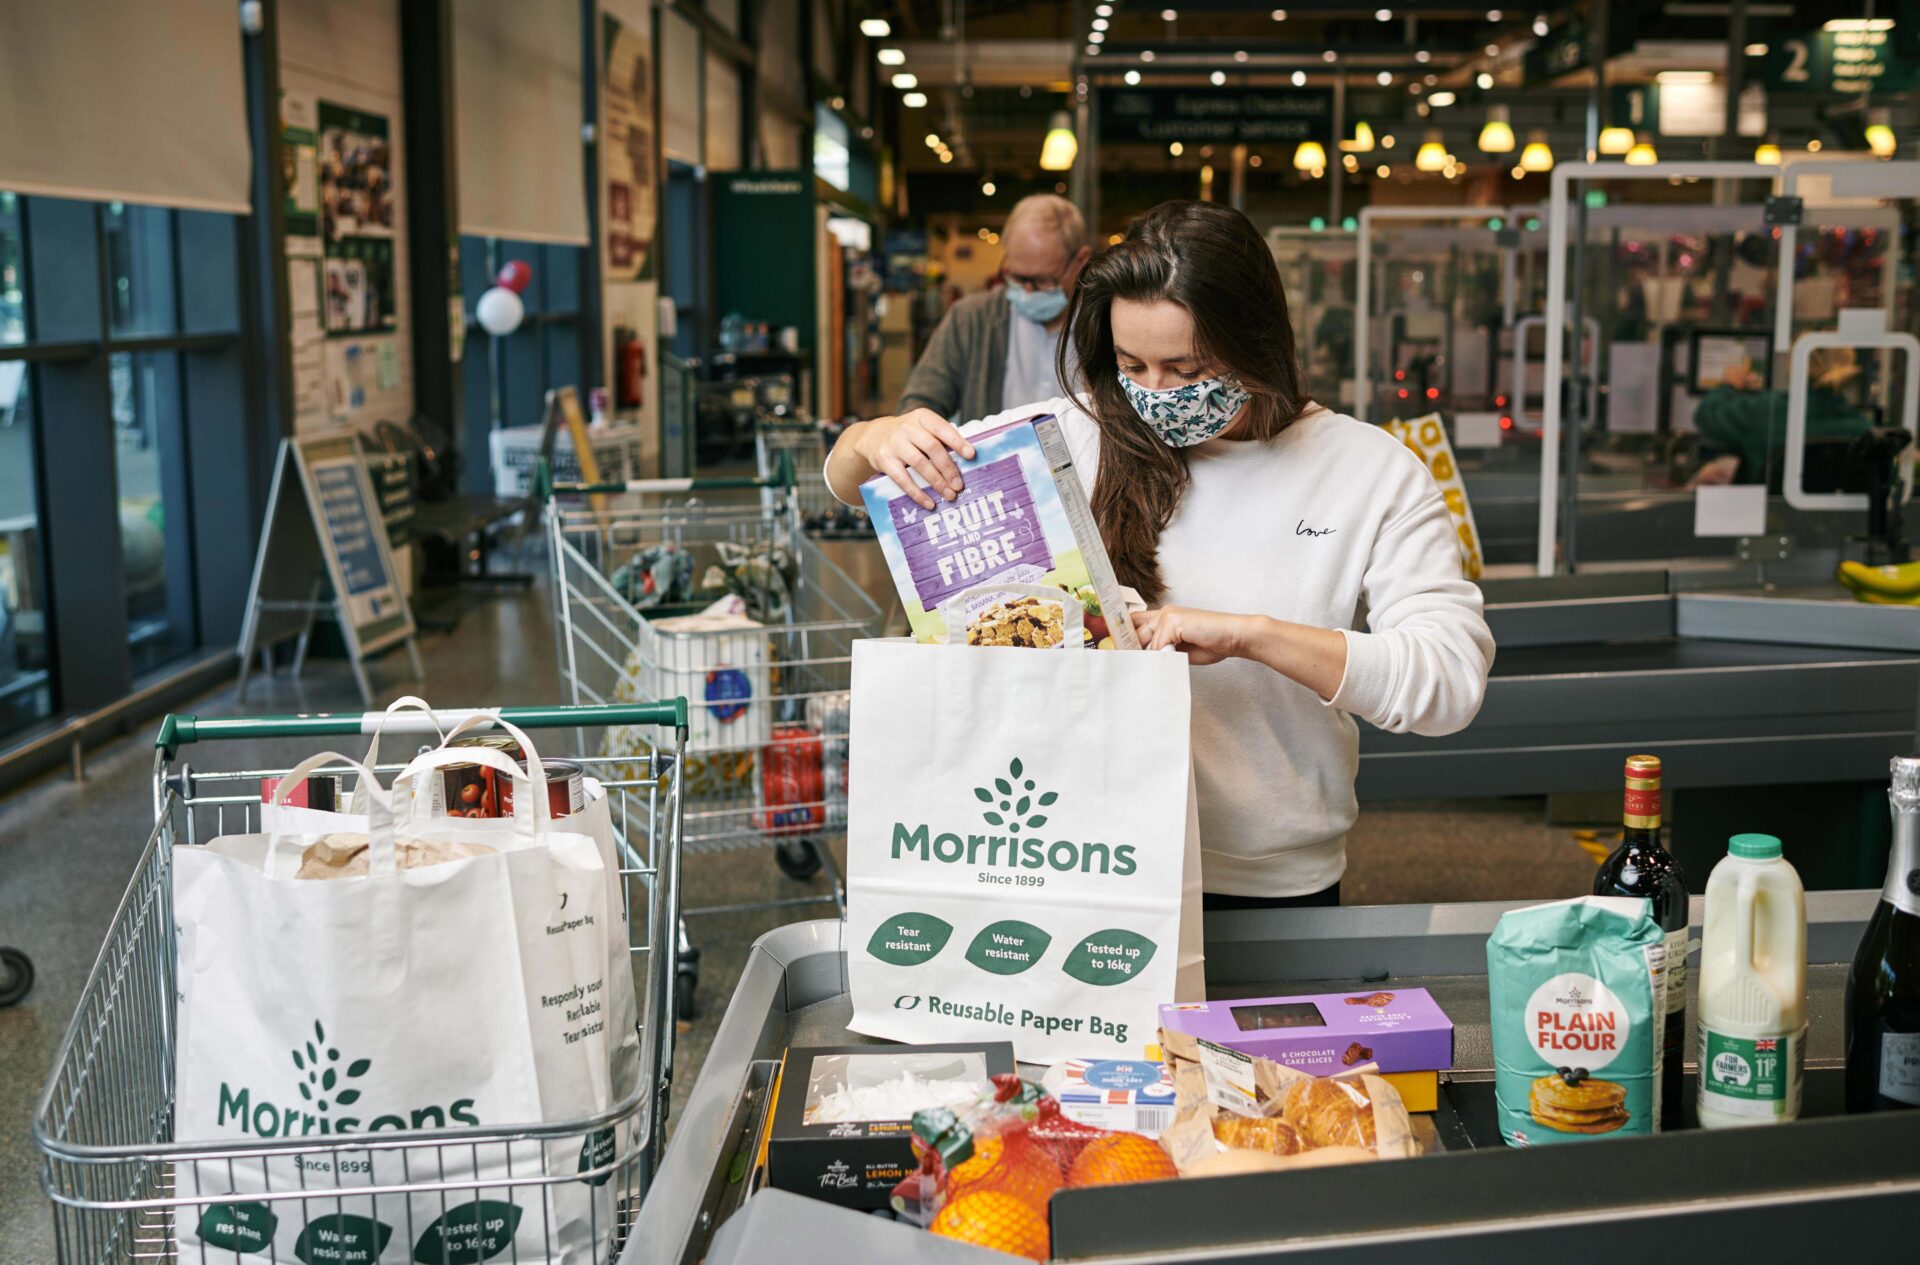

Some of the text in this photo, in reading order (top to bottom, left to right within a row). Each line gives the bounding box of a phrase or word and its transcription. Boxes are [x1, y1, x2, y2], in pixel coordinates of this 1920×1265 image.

[1783, 40, 1809, 81] 2
[923, 490, 1007, 545] FRUIT
[963, 532, 981, 546] AND
[937, 531, 1022, 586] FIBRE
[891, 822, 1137, 876] Morrisons
[978, 872, 1045, 887] Since 1899
[897, 926, 920, 937] Tear
[885, 940, 931, 952] resistant
[992, 934, 1024, 946] Water
[985, 948, 1030, 962] resistant
[1085, 943, 1140, 959] Tested up
[1091, 958, 1132, 974] to 16kg
[929, 996, 1128, 1043] Reusable Paper Bag
[1537, 1011, 1615, 1032] PLAIN
[1538, 1032, 1616, 1050] FLOUR
[1289, 1049, 1335, 1058] CHOCOLATE
[1307, 1056, 1333, 1064] SLICES
[1725, 1054, 1738, 1064] FOR
[1716, 1060, 1748, 1074] FARMERS
[295, 1155, 371, 1173] Snce 899
[866, 1169, 902, 1178] LEMON
[215, 1222, 262, 1241] resstant
[485, 1218, 504, 1232] up
[318, 1229, 358, 1244] Waer
[313, 1246, 368, 1260] resisant
